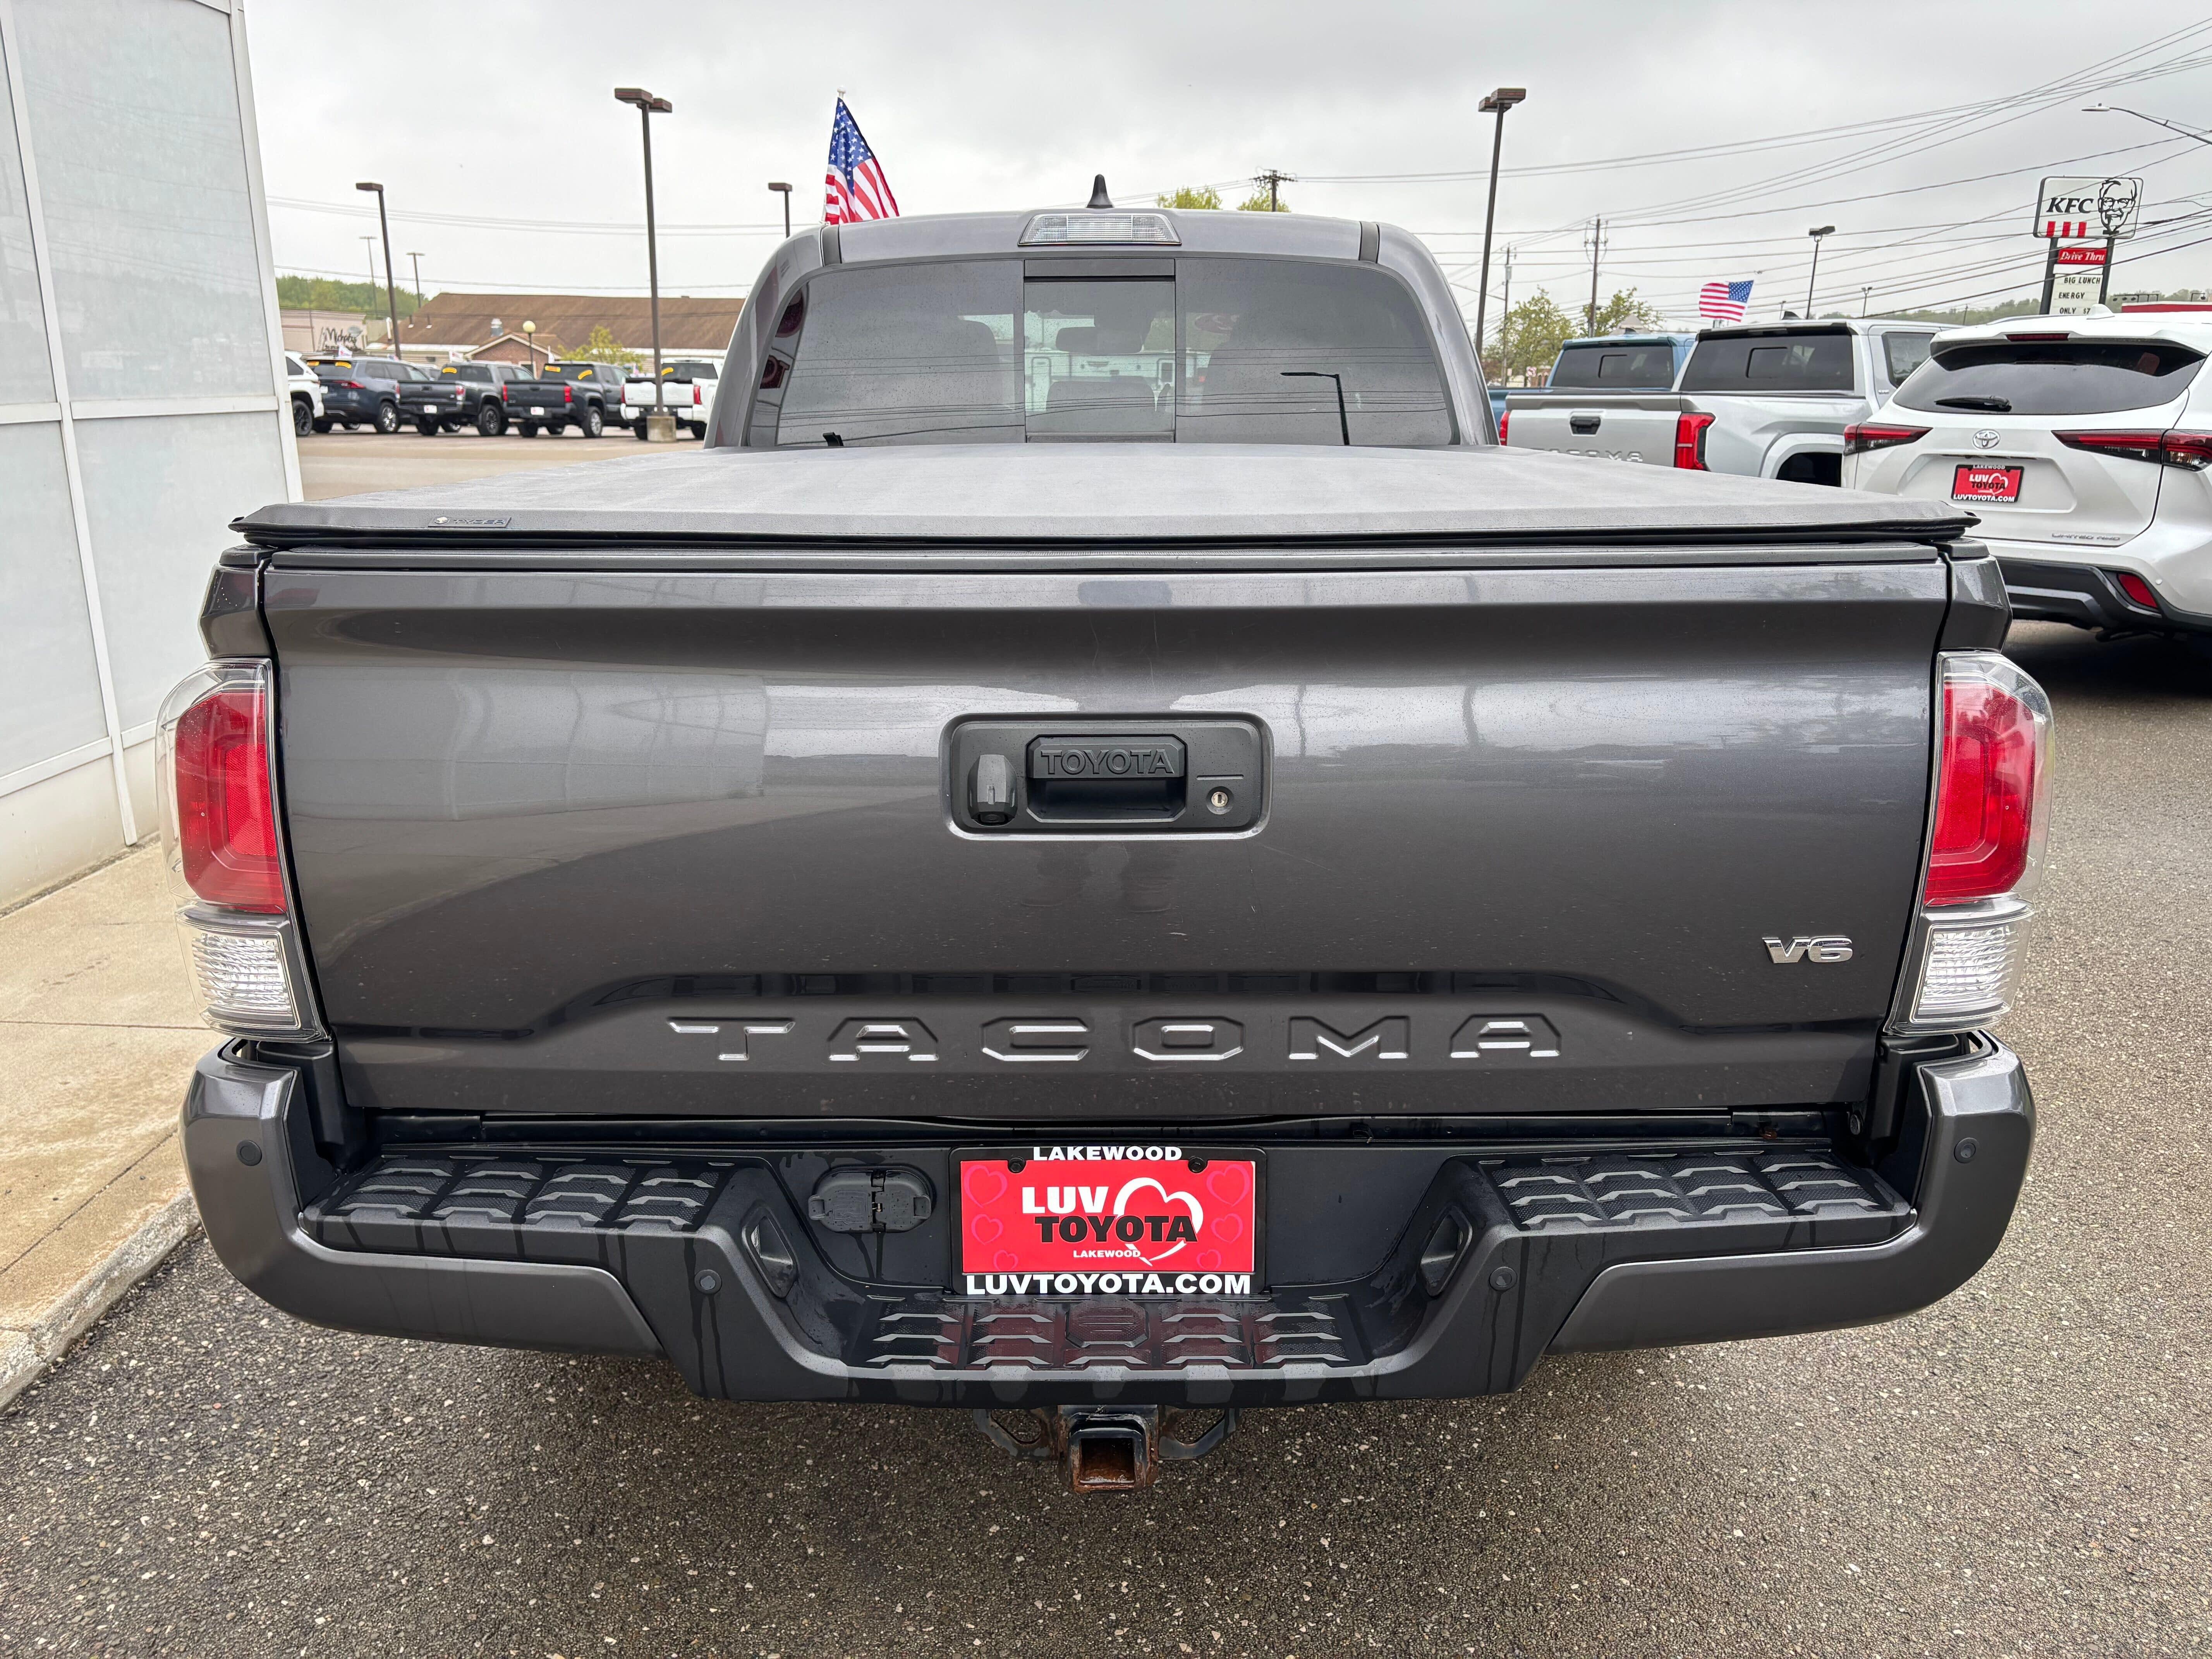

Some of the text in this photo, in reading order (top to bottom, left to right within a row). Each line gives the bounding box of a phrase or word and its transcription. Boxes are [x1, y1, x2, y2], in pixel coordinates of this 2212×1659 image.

[2046, 198, 2094, 213] KFC
[2060, 251, 2105, 261] Drive Thru
[1969, 474, 1989, 483] LUV
[1972, 481, 2006, 489] TOYOTA
[1953, 493, 2015, 503] LUVTOYOTA.COM
[1041, 749, 1175, 775] TOYOTA
[1762, 935, 1853, 963] V6
[668, 1013, 1561, 1060] TACOMA
[1033, 1146, 1182, 1161] LAKEWOOD
[1022, 1186, 1109, 1214] LUV
[1035, 1215, 1198, 1243] TOYOTA
[1073, 1250, 1141, 1258] LAKEWOOD
[966, 1274, 1250, 1295] LUVTOYOTA.COM
